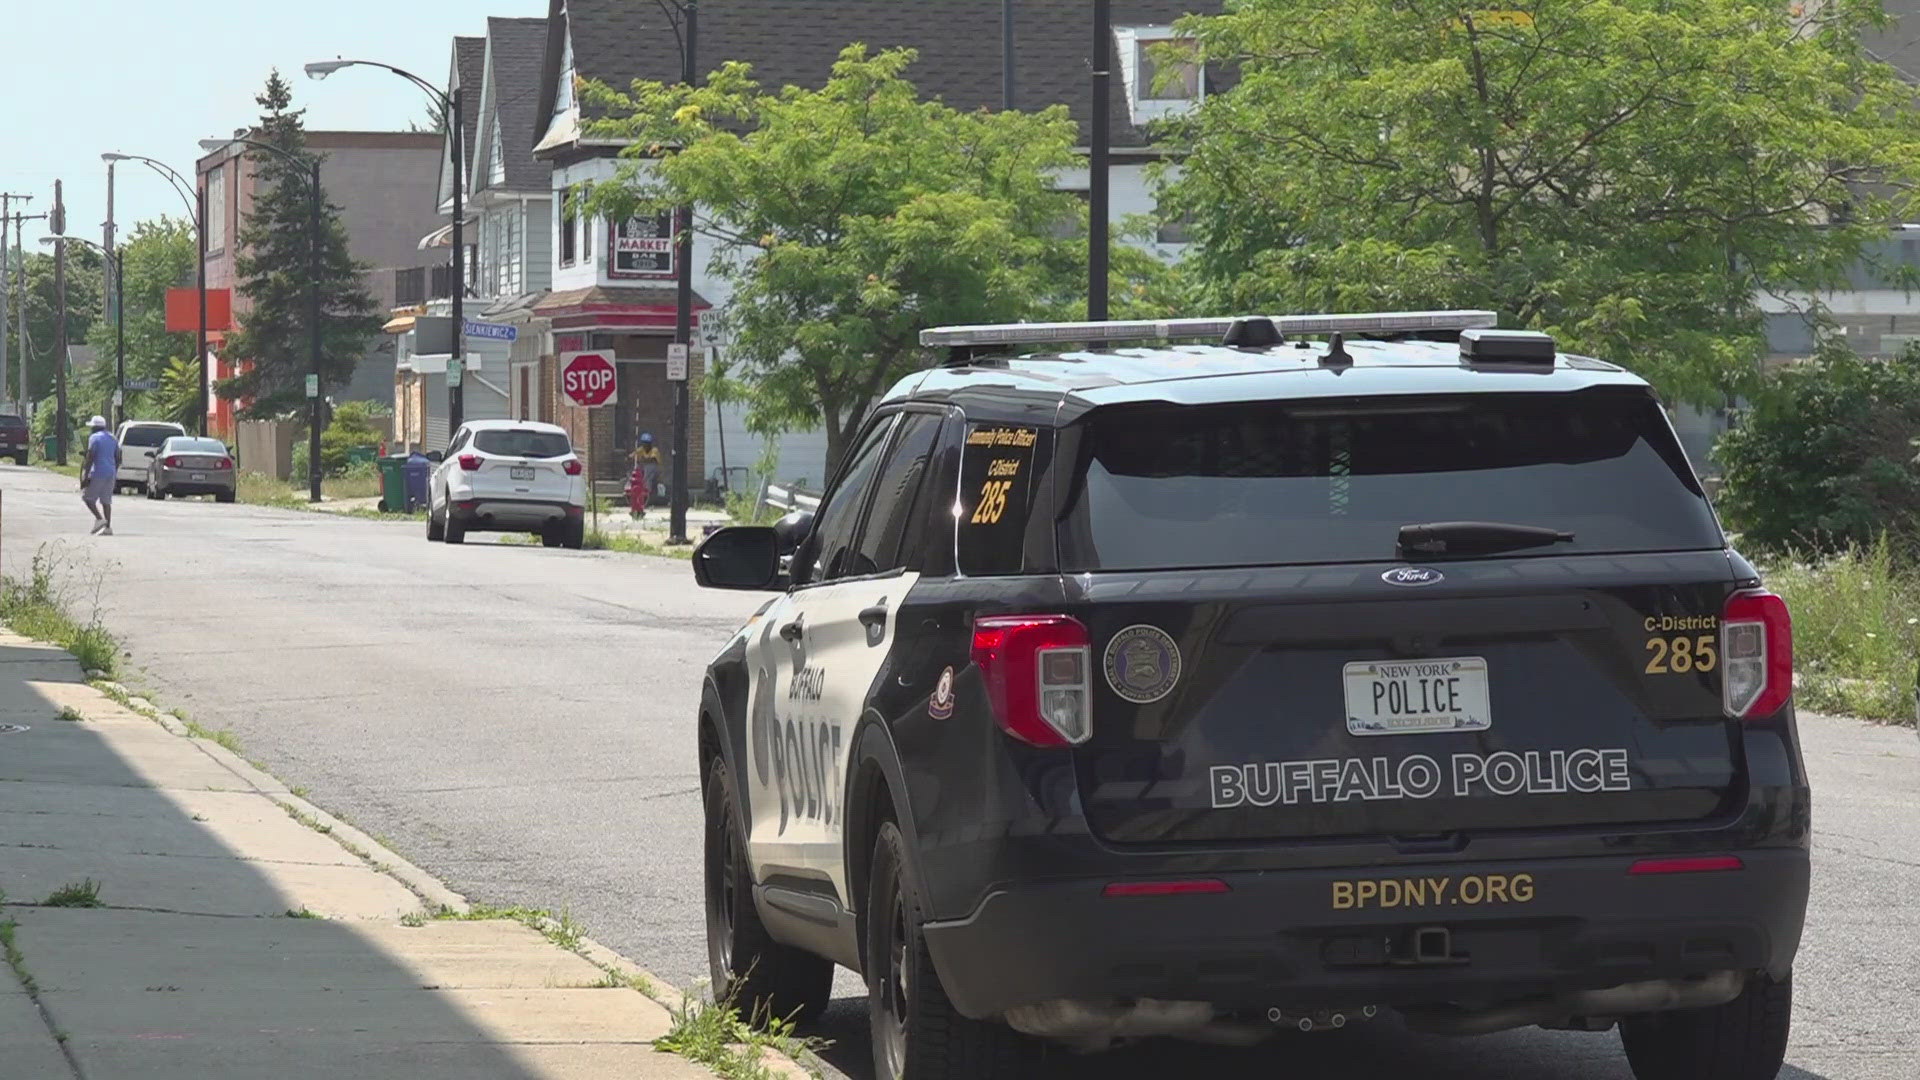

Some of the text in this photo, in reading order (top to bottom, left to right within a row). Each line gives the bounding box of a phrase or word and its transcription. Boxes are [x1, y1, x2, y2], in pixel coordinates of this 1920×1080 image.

[618, 239, 669, 250] MARKET
[701, 312, 722, 323] ONE
[465, 323, 509, 339] SIENKIEWICZ
[566, 369, 613, 392] STOP
[966, 428, 1037, 449] Community Police Officer
[987, 459, 1020, 476] C-District
[971, 481, 1012, 524] 285
[1397, 568, 1430, 581] Ford
[1644, 614, 1717, 632] C-District
[1645, 635, 1717, 675] 285
[1380, 664, 1451, 679] NEW YORK
[789, 667, 825, 700] BUFFALO
[1372, 677, 1462, 716] POLICE
[772, 717, 842, 838] POLICE
[1210, 749, 1631, 808] BUFFALO POLICE
[1332, 873, 1535, 909] BPDNY.ORG
